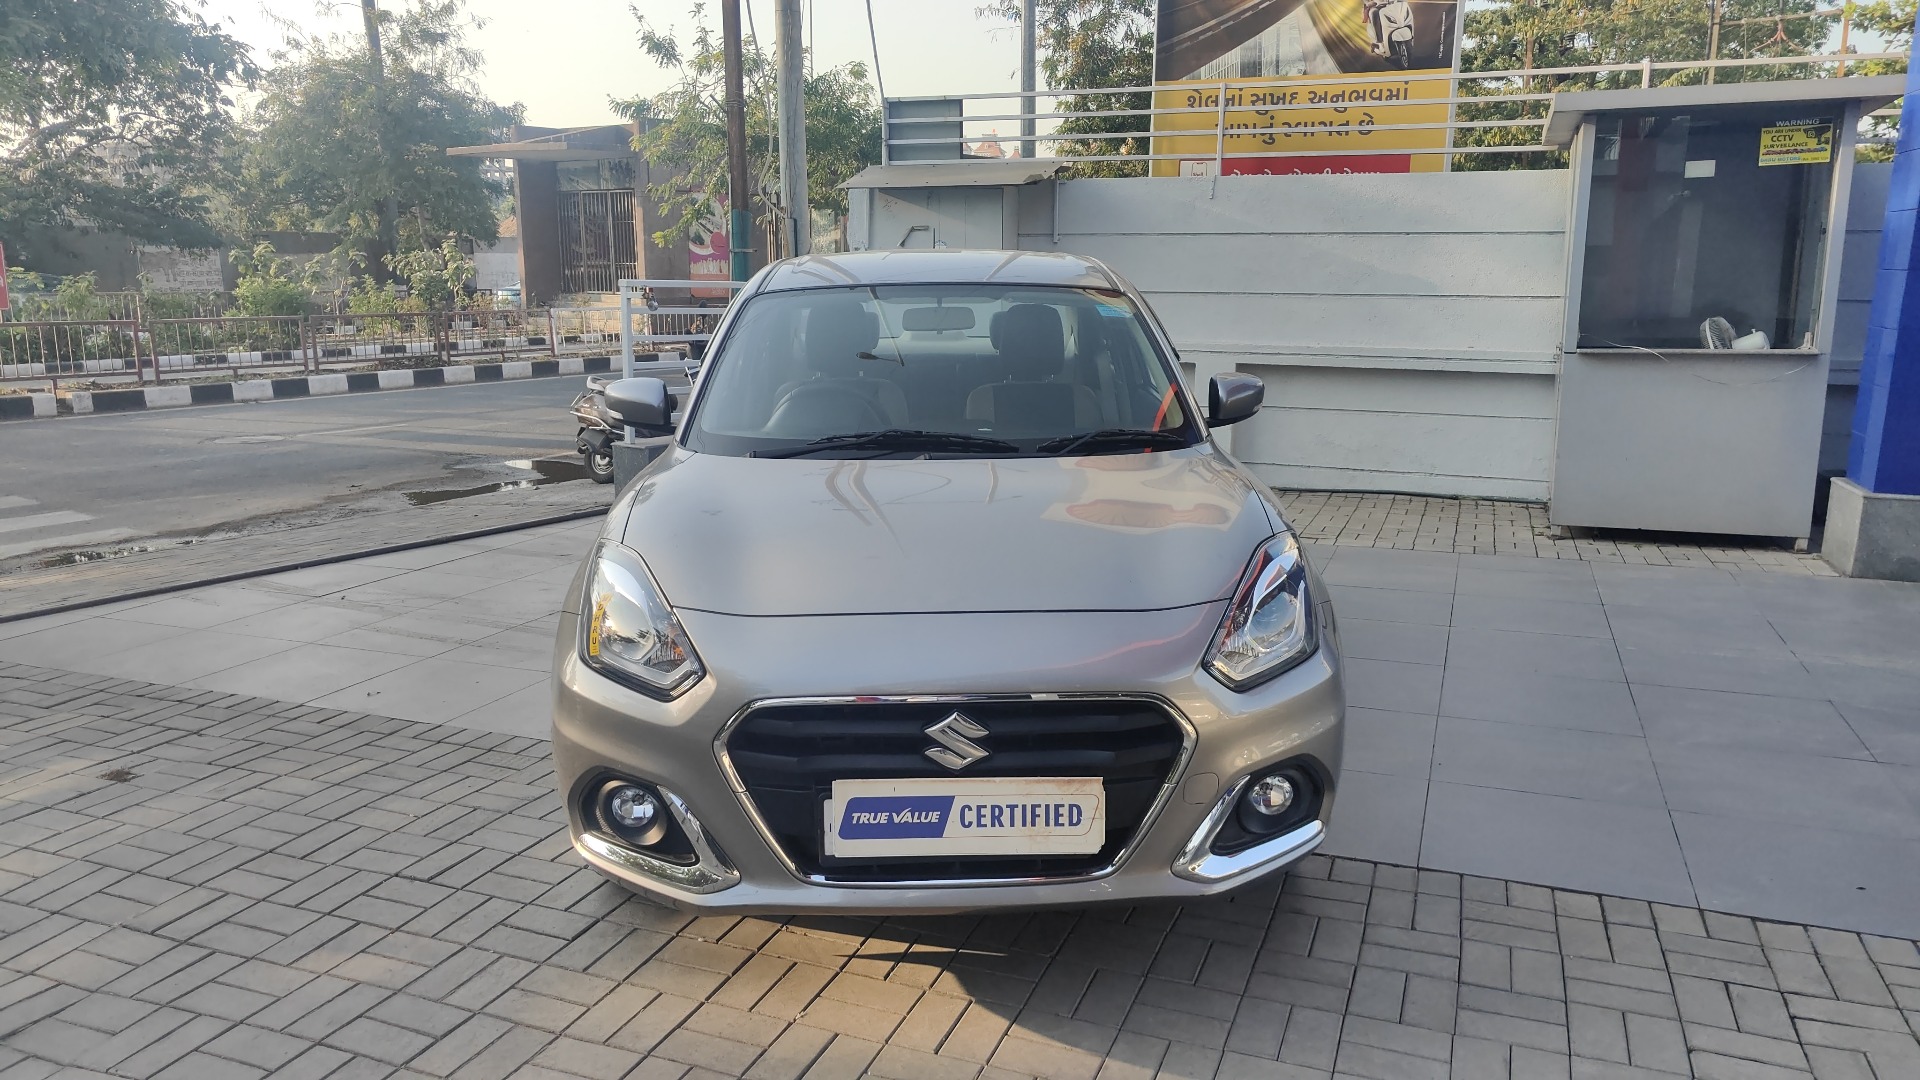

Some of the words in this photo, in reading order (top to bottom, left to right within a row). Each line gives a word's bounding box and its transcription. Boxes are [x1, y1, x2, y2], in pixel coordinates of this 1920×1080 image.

[1776, 118, 1820, 127] WARNING
[1771, 134, 1795, 143] CCTV
[1763, 142, 1809, 150] SURVEILLANCE
[851, 812, 890, 825] TRUE
[892, 808, 941, 825] VALUE
[959, 803, 1084, 829] CERTIFIED
